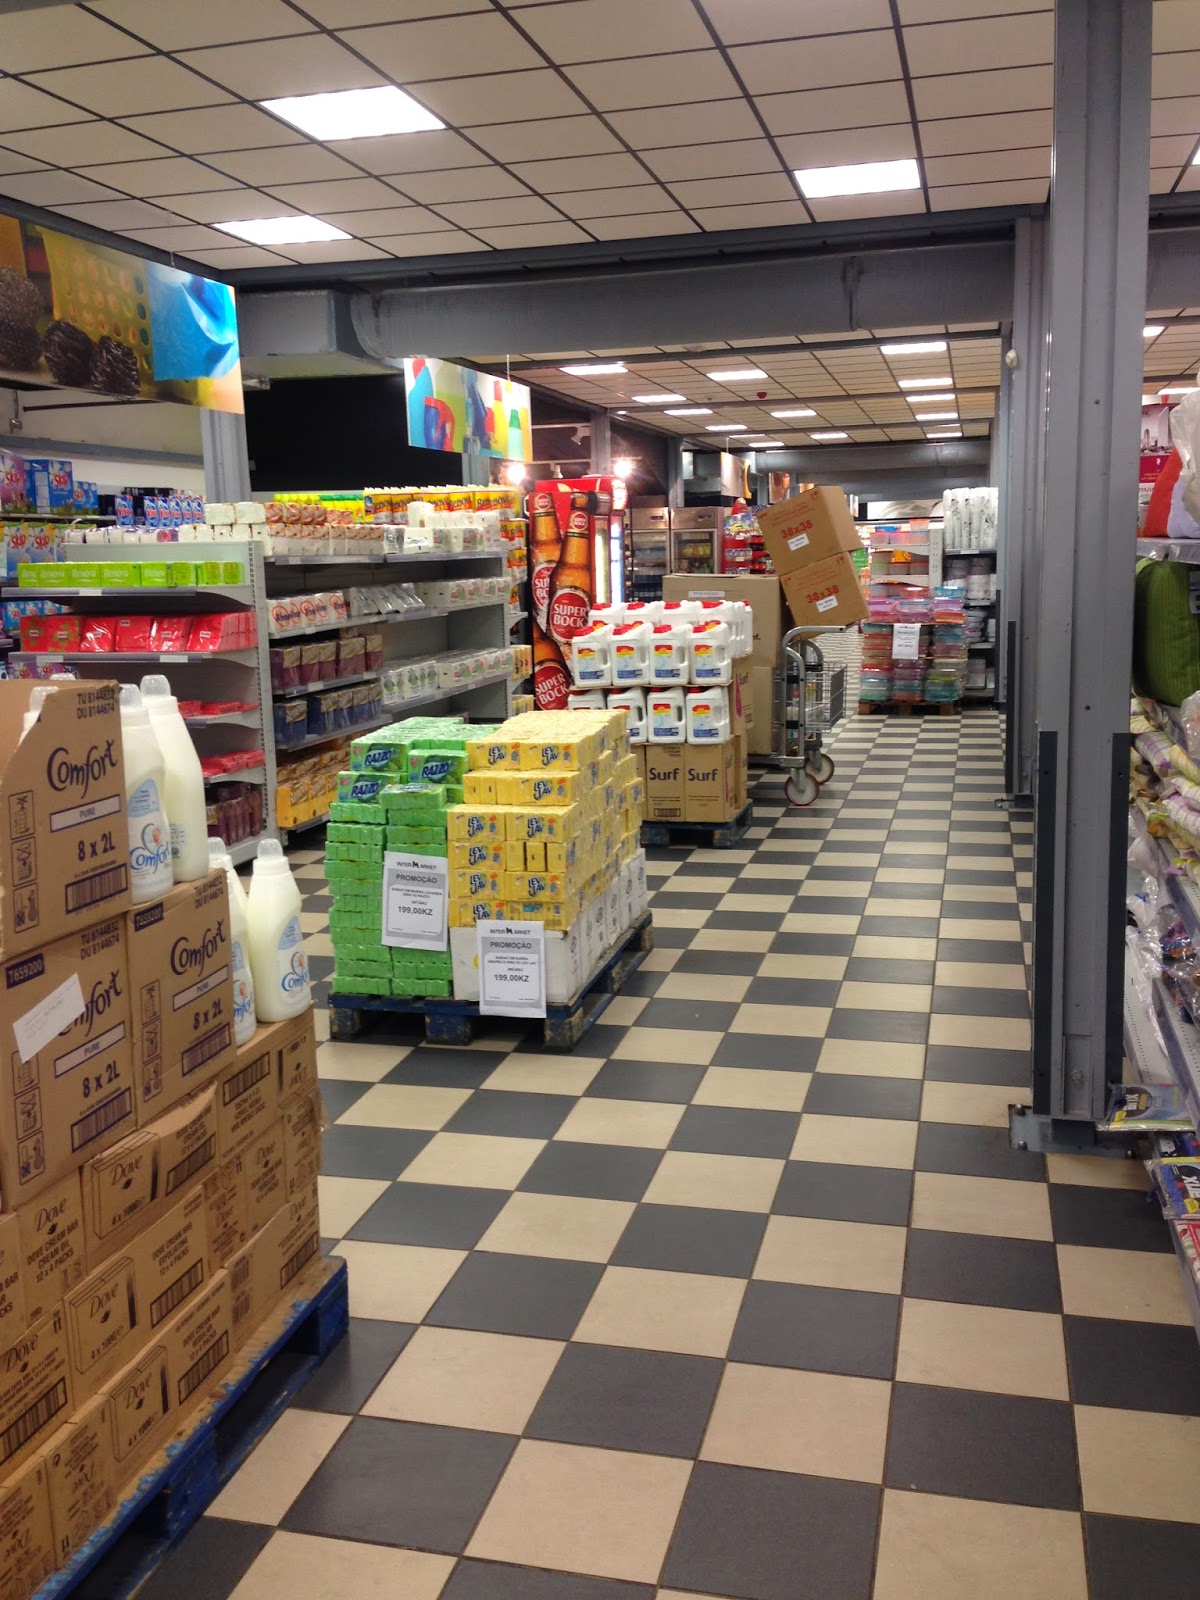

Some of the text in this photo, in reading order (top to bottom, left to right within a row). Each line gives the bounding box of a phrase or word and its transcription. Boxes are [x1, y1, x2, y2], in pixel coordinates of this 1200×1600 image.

[553, 603, 588, 617] SUPER
[553, 615, 585, 628] BOCK
[535, 673, 566, 693] SUPER
[538, 684, 570, 705] BOCK
[365, 749, 392, 766] RAZZO
[47, 739, 117, 799] Comfort
[422, 762, 450, 777] RAZZO
[649, 767, 680, 781] Surf
[688, 768, 719, 782] Surf
[351, 782, 380, 798] RAZZO
[80, 807, 95, 818] PURE
[78, 840, 86, 862] 8
[101, 831, 116, 854] 2L
[396, 874, 437, 884] PROMOÇÃO
[398, 906, 433, 916] 199,00KZ
[170, 919, 226, 977] Comfort
[490, 941, 532, 950] PROMOÇÃO
[8, 959, 43, 984] T659200
[494, 974, 530, 983] 199,00KZ
[58, 969, 122, 1037] mfort
[84, 1042, 100, 1056] PURE
[83, 1077, 90, 1098] 8
[106, 1060, 120, 1084] 2L
[111, 1155, 143, 1186] Dove
[35, 1199, 67, 1232] Dove
[27, 1219, 79, 1265] DOVE CREAM BAR
[38, 1247, 60, 1269] CREAM
[5, 1272, 18, 1289] BAR
[90, 1283, 118, 1318] Dove
[0, 1302, 13, 1318] CKS
[6, 1335, 38, 1373] Dove
[126, 1372, 153, 1409] Dove
